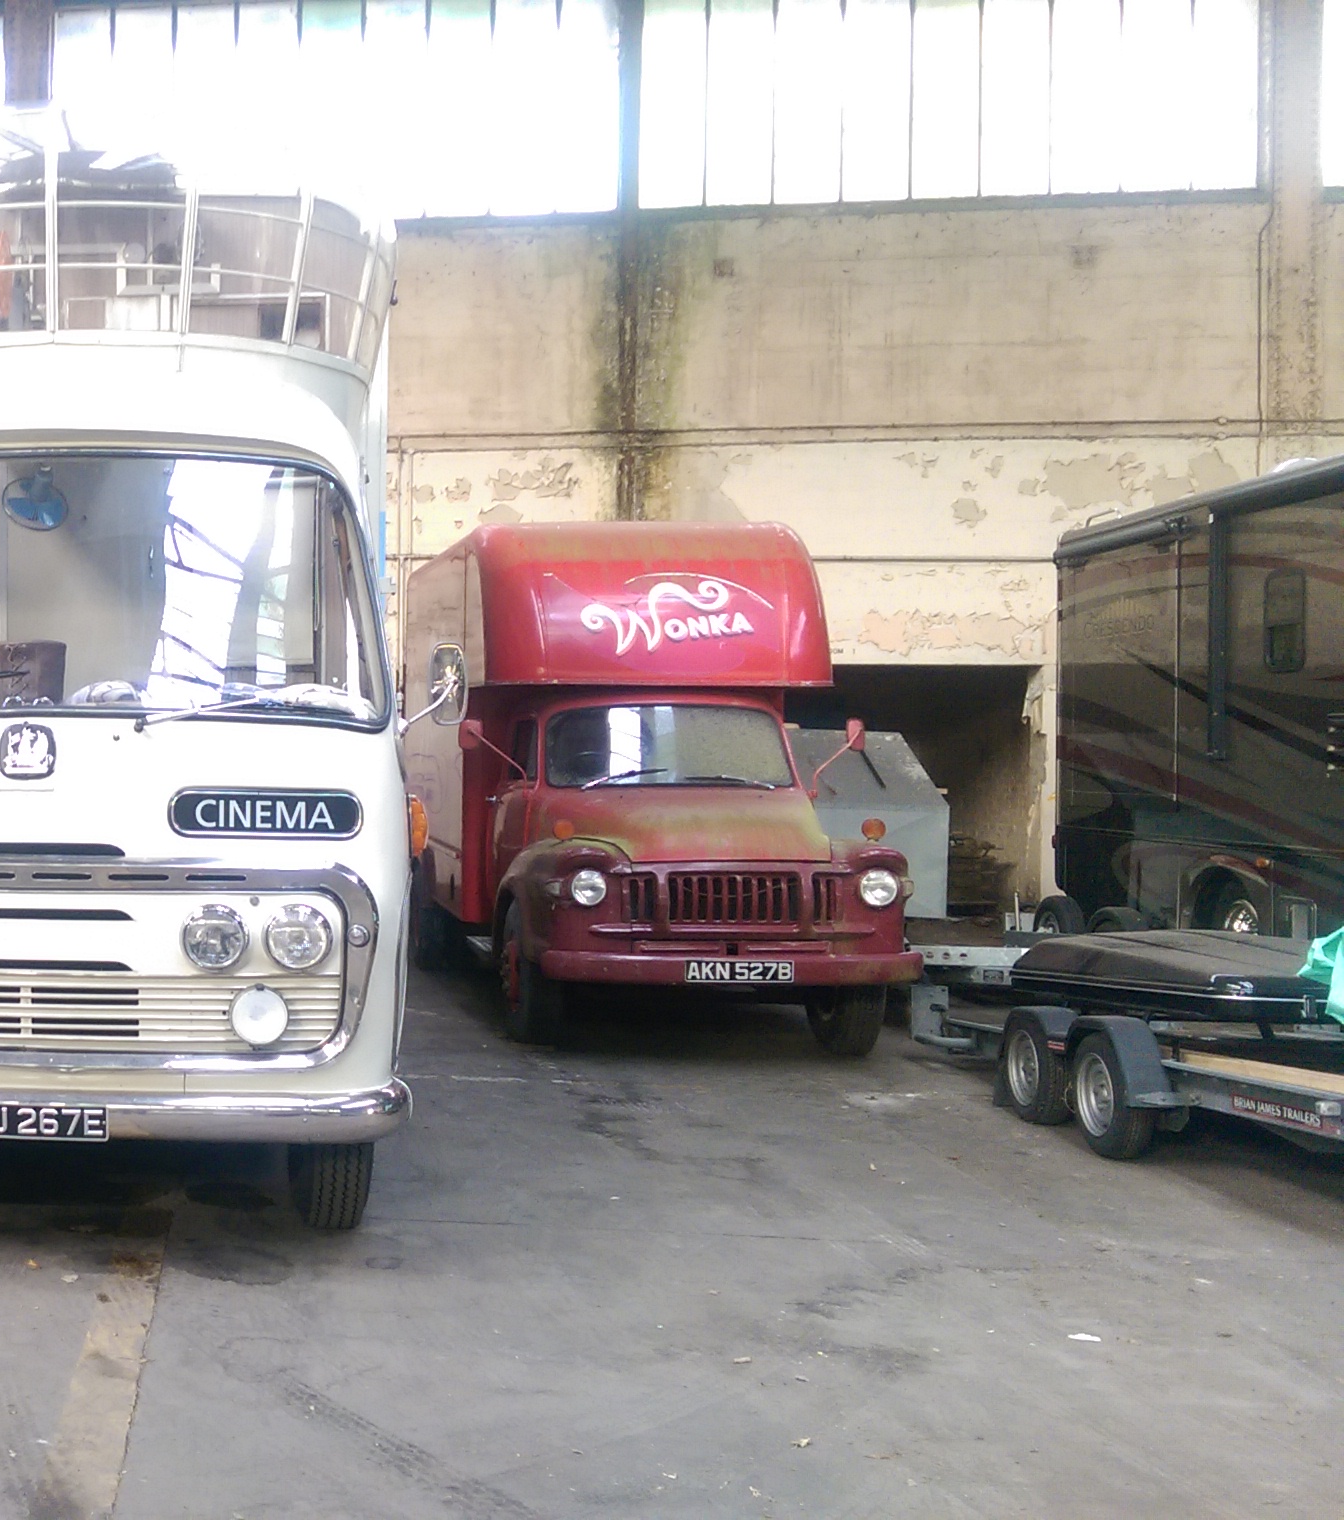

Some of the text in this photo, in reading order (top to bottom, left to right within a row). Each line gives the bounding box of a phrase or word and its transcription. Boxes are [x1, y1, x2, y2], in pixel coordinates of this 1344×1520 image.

[580, 579, 754, 656] WONKA
[194, 798, 335, 830] CINEMA
[687, 961, 792, 981] AKN 527B
[16, 1107, 104, 1136] 267E
[1233, 1095, 1321, 1128] BRIAN JAMES TRAILERS
